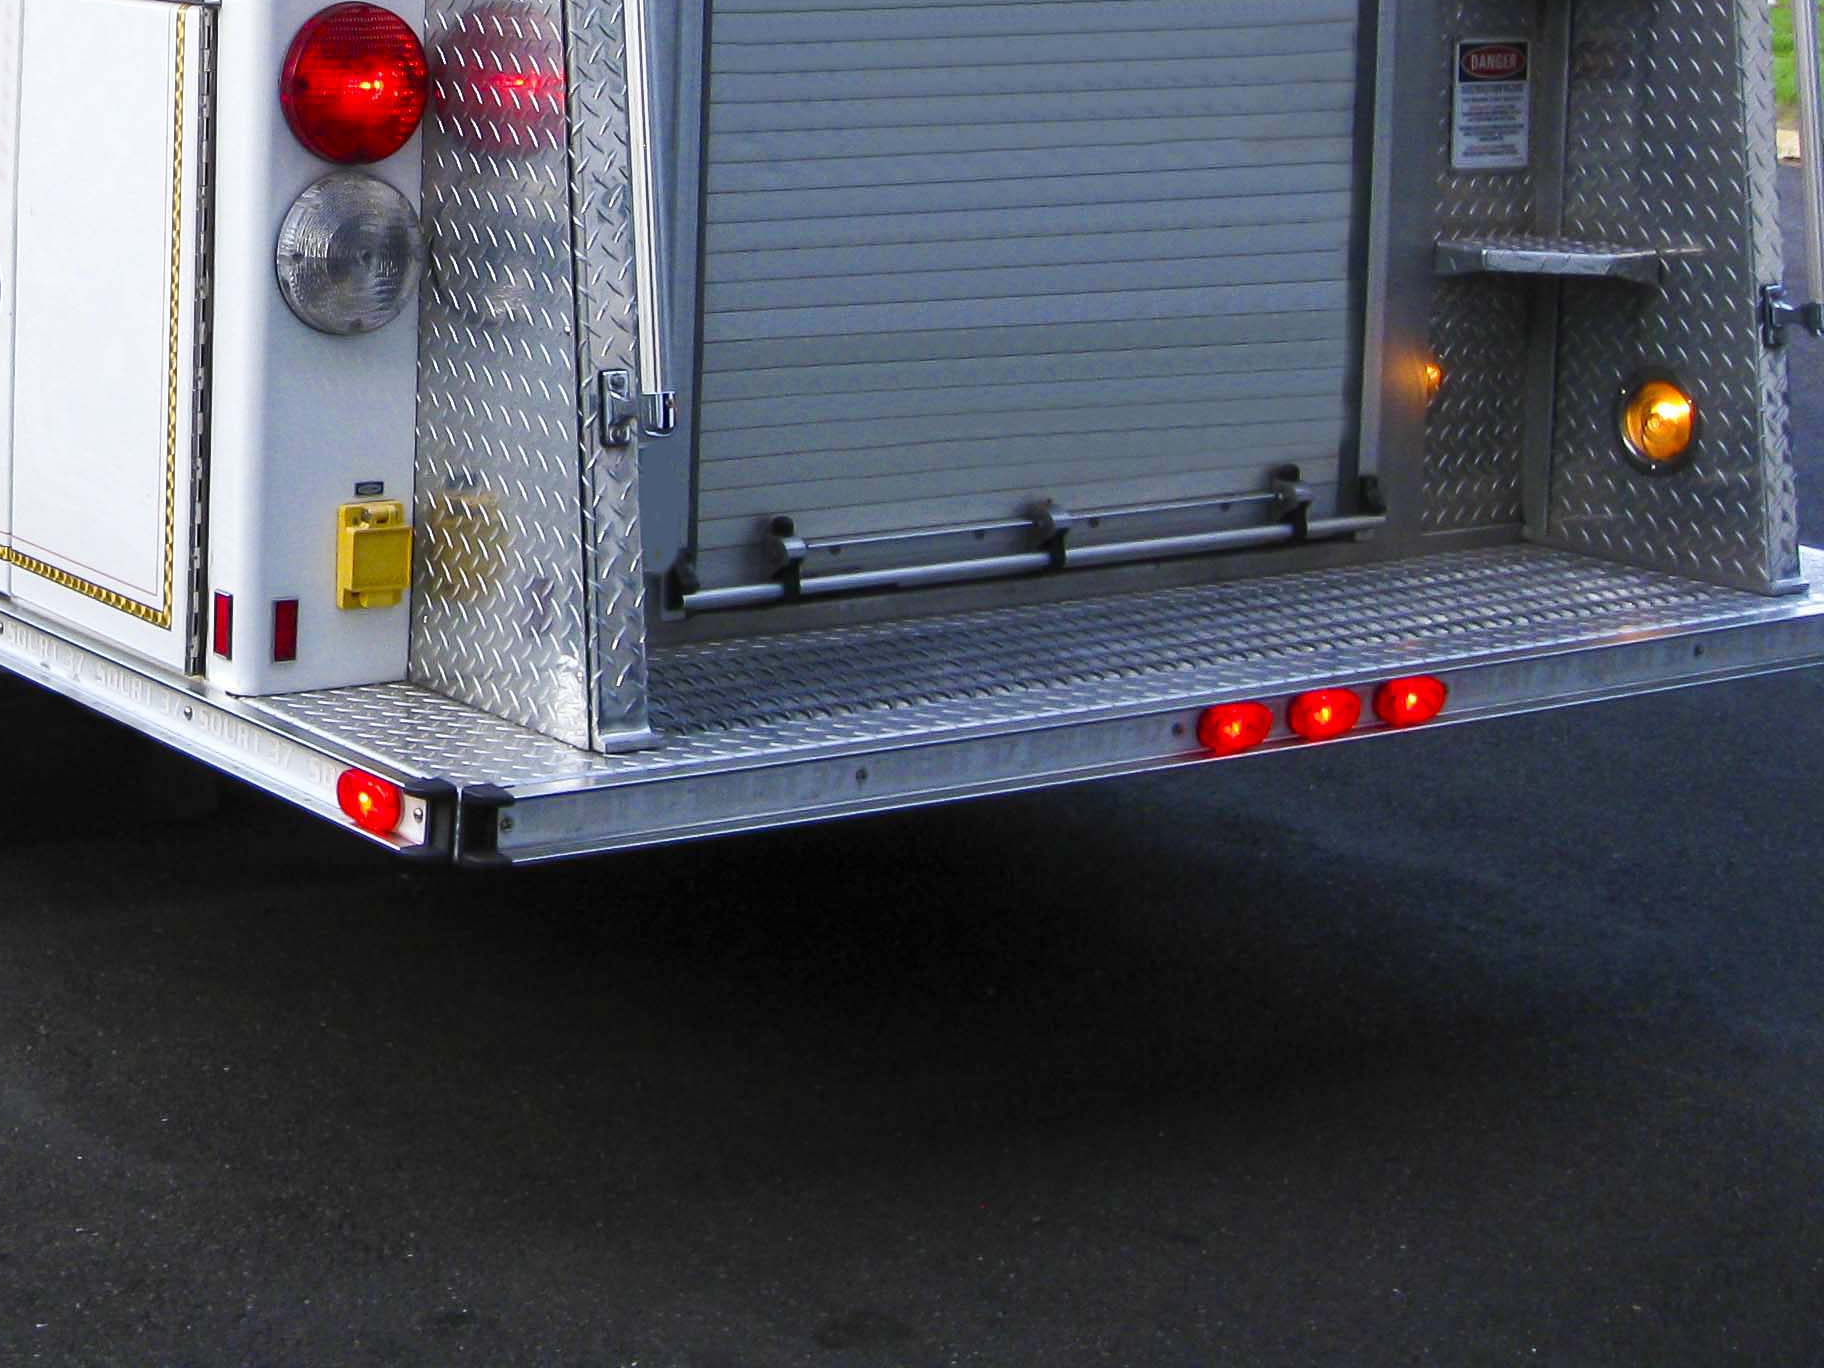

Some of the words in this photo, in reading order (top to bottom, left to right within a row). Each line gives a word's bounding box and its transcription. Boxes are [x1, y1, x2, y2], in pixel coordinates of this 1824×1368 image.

[1471, 53, 1517, 71] DANGER
[63, 642, 84, 674] 37
[96, 657, 152, 705] SQURT
[160, 686, 181, 719] 37
[198, 702, 261, 753] SQURT
[269, 734, 292, 769] 37
